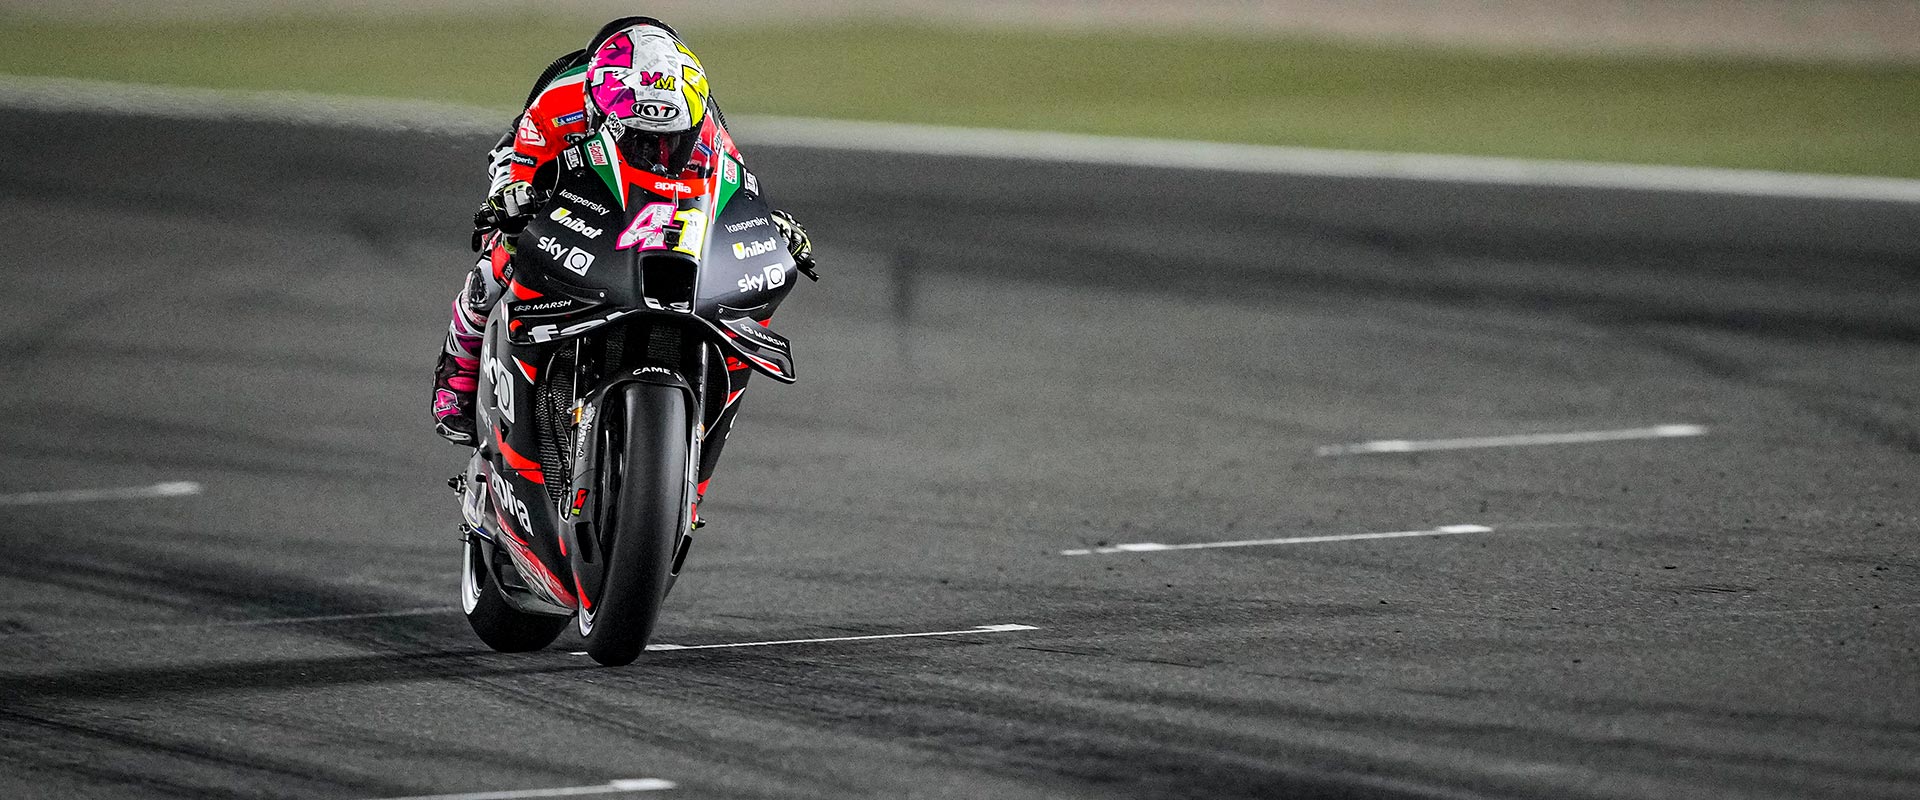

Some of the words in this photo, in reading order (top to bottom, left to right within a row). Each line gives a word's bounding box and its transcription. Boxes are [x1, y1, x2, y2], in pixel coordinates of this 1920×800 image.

[654, 181, 692, 194] aprilia
[559, 189, 610, 216] kaspersky
[549, 206, 603, 239] Unibat
[615, 202, 708, 260] 41
[725, 216, 770, 233] kaspersky
[537, 236, 569, 260] sky
[732, 237, 777, 260] Unibat
[737, 273, 764, 293] sky
[532, 300, 572, 310] MARSH
[754, 329, 787, 348] MARSH
